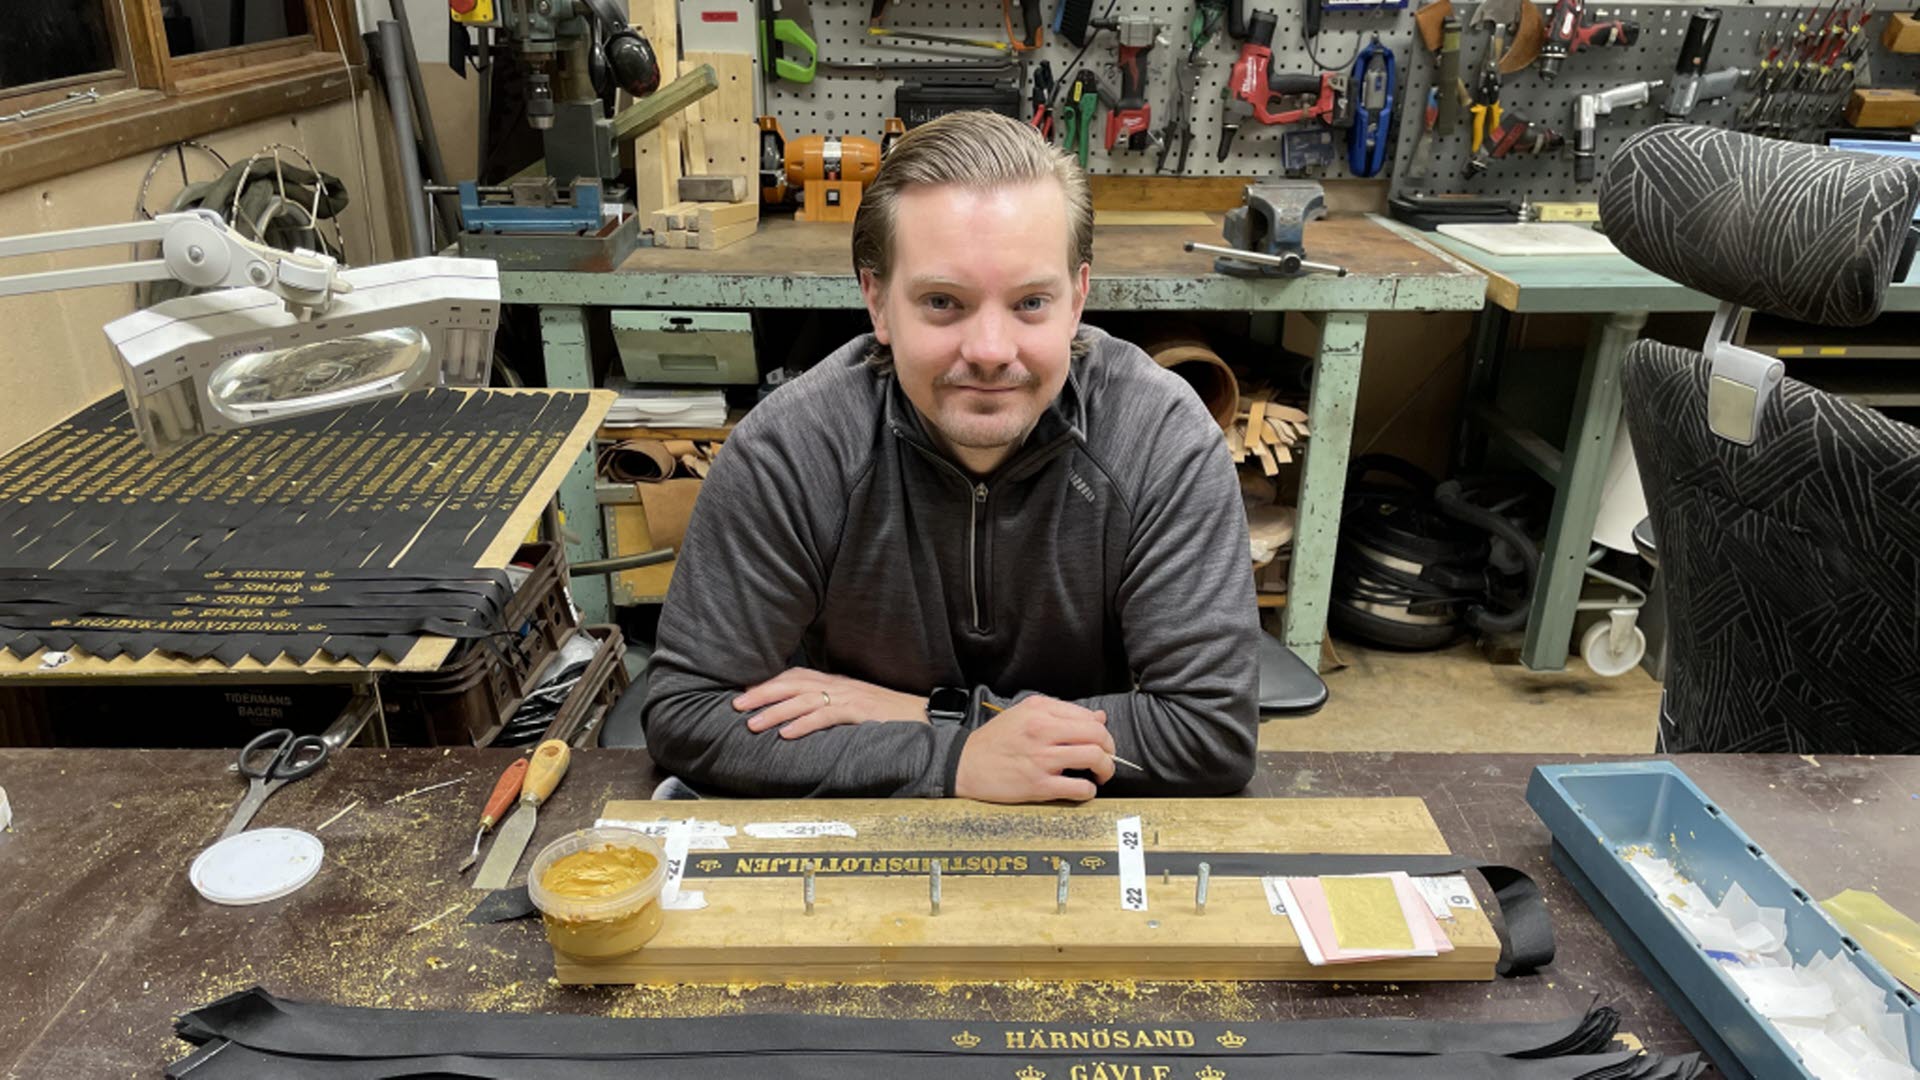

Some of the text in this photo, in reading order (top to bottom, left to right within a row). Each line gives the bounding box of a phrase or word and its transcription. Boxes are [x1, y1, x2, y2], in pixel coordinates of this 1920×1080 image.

[224, 692, 293, 706] TIDERMANS
[237, 705, 283, 719] BAGERI
[1005, 1029, 1196, 1050] HÄRNÖSAND
[1070, 1061, 1171, 1080] GÄVLE
